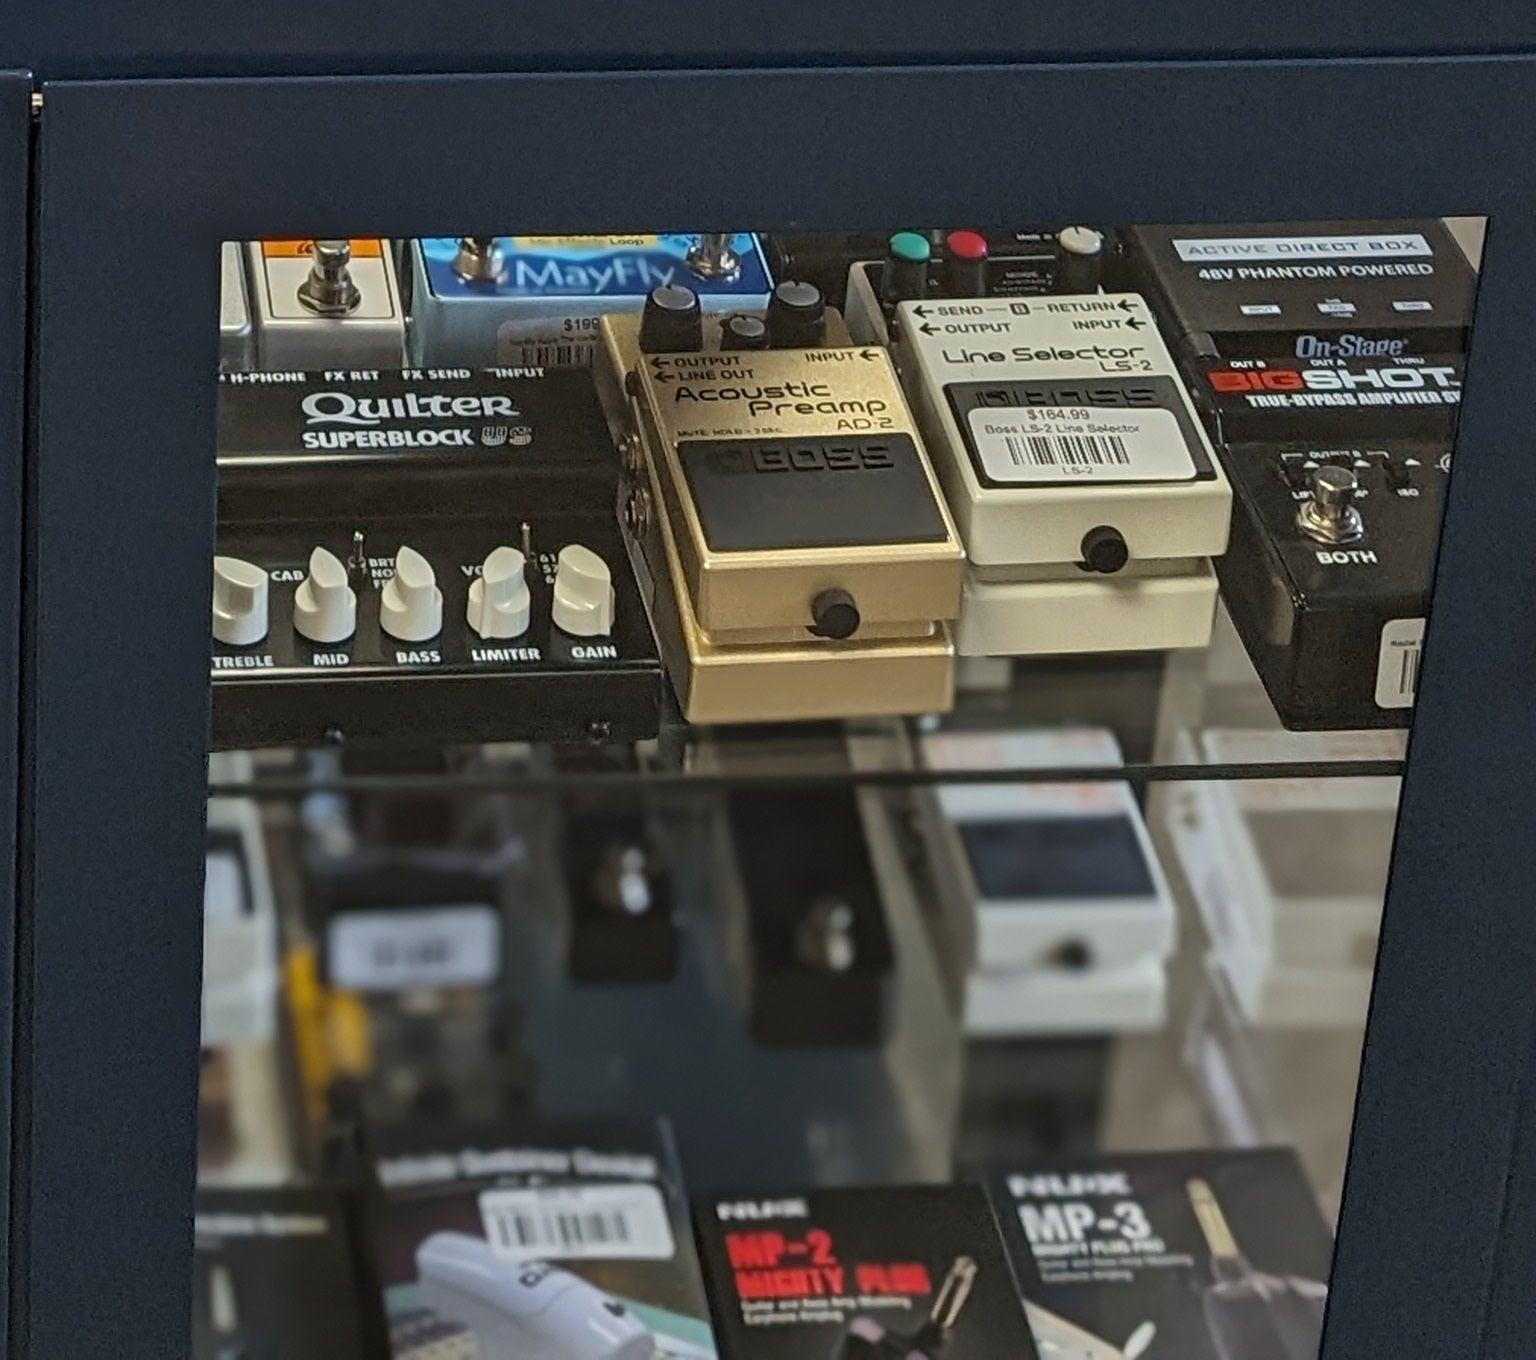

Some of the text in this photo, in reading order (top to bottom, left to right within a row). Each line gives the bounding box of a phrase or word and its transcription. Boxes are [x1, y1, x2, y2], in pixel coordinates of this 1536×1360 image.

[1188, 240, 1418, 255] ACTIVE DIRECT BOX
[515, 255, 675, 294] MayFly
[1198, 262, 1434, 281] 48V PHANTOM POWERED
[937, 305, 984, 316] SEND
[1046, 302, 1114, 313] RETURN
[945, 323, 1011, 333] OUTPUT
[1073, 318, 1122, 330] INPUT
[1296, 335, 1404, 359] On-Stage
[805, 351, 855, 363] INPUT
[942, 345, 1145, 364] Line Selector
[675, 356, 741, 367] OUTPUT
[1099, 360, 1153, 372] LS-2
[230, 371, 307, 383] H-PHONE
[324, 370, 380, 381] FX RET
[402, 368, 471, 380] FX SEND
[495, 367, 545, 378] INPUT
[678, 368, 755, 380] LINE OUT
[1208, 367, 1457, 393] BIGSHOT
[674, 381, 831, 402] Acoustic
[1245, 392, 1440, 408] TRUE-BYPASS AMPLIFIER
[749, 399, 887, 417] Preamp
[1027, 408, 1090, 421] $164.99
[836, 417, 895, 431] AD-2
[1022, 423, 1052, 434] LS-2
[1056, 423, 1083, 433] Line
[1087, 423, 1140, 434] Selector
[302, 428, 474, 449] SUPERBLOCK
[1063, 467, 1093, 476] LS-2
[1316, 551, 1379, 565] BOTH
[271, 569, 304, 581] CAB
[396, 651, 441, 664] BASS
[471, 648, 541, 662] LIMITER
[572, 646, 617, 659] GAIN
[212, 655, 274, 668] TREBLE
[313, 653, 349, 666] MID
[1018, 1201, 1152, 1243] MP-3
[725, 1229, 837, 1268] MP-2
